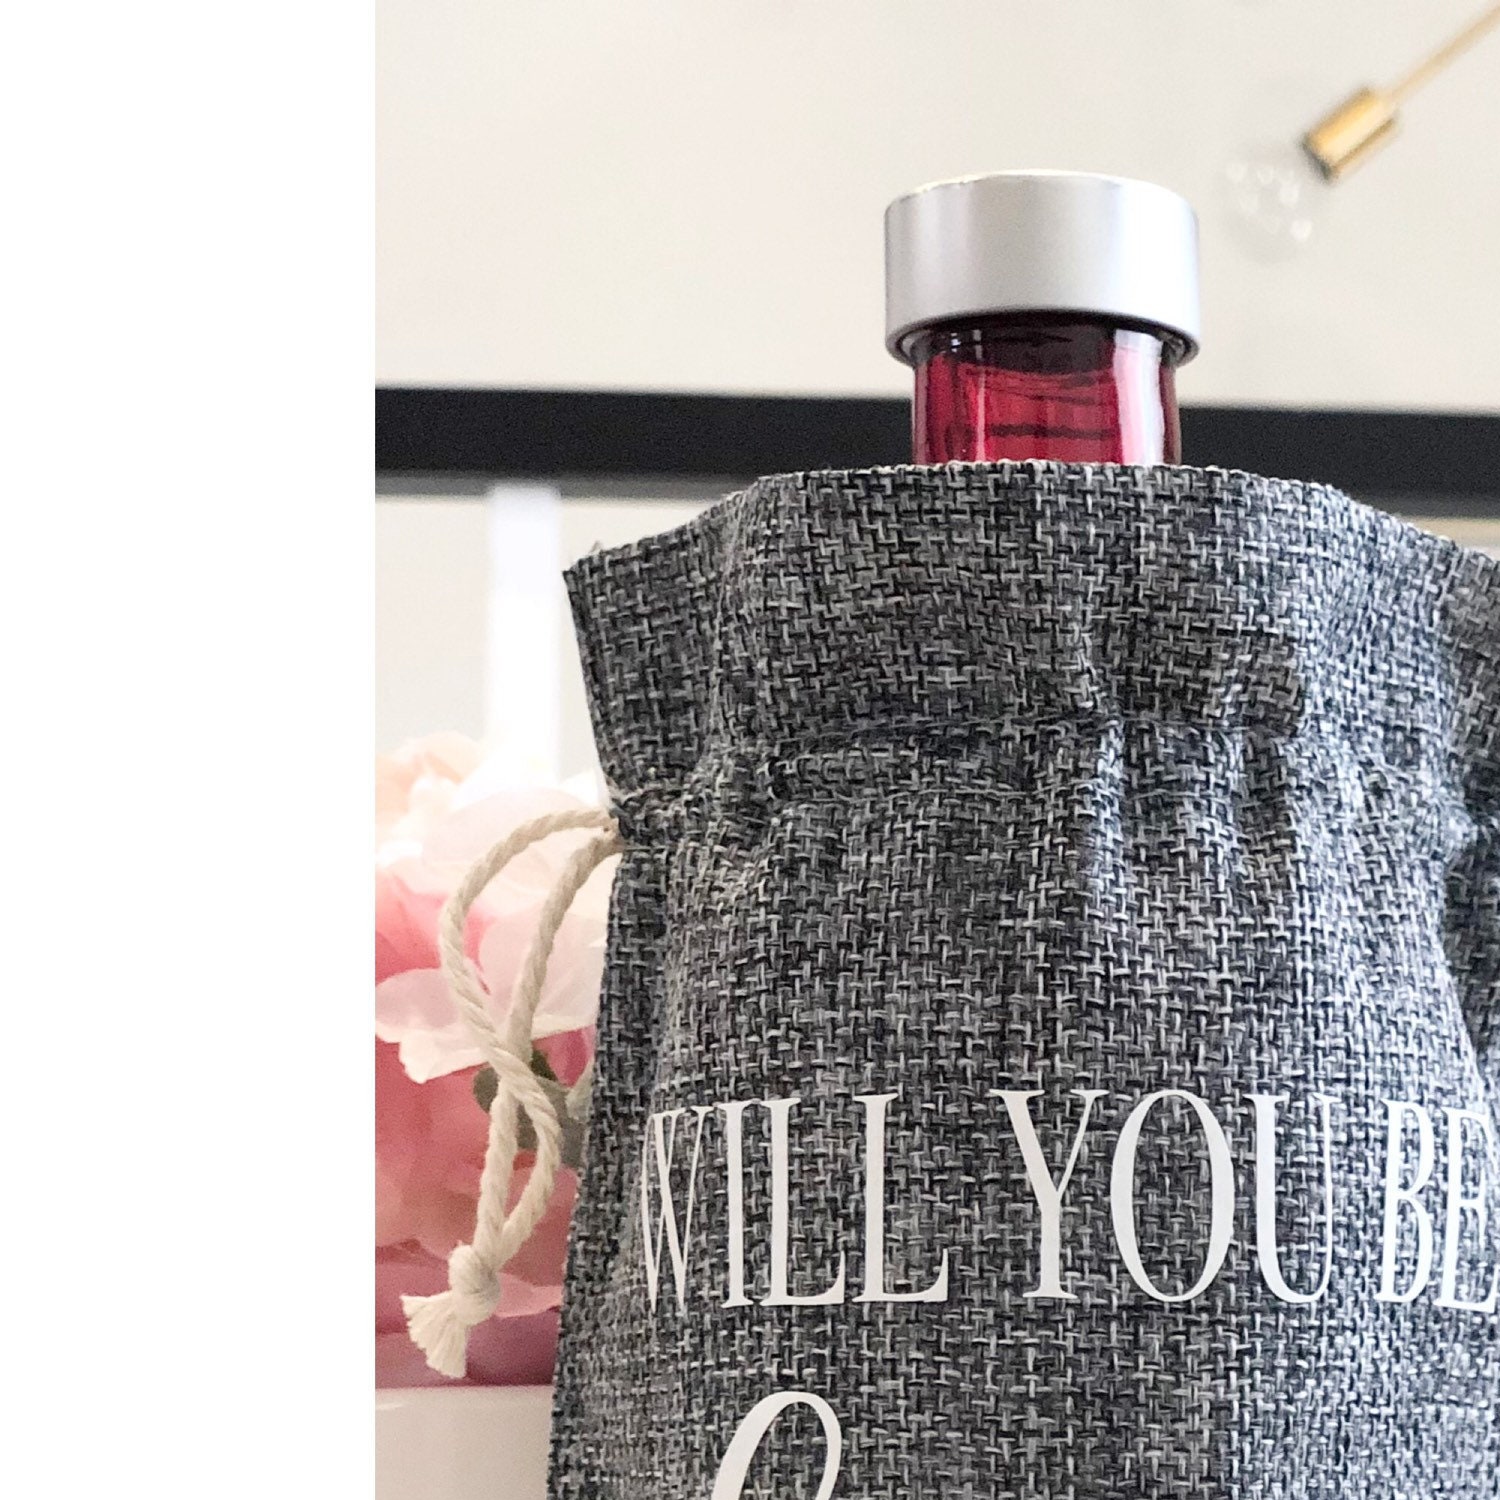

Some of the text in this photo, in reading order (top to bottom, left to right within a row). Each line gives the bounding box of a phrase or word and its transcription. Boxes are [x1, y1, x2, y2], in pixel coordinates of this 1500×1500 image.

[640, 1088, 1498, 1315] WILL YOU BE
